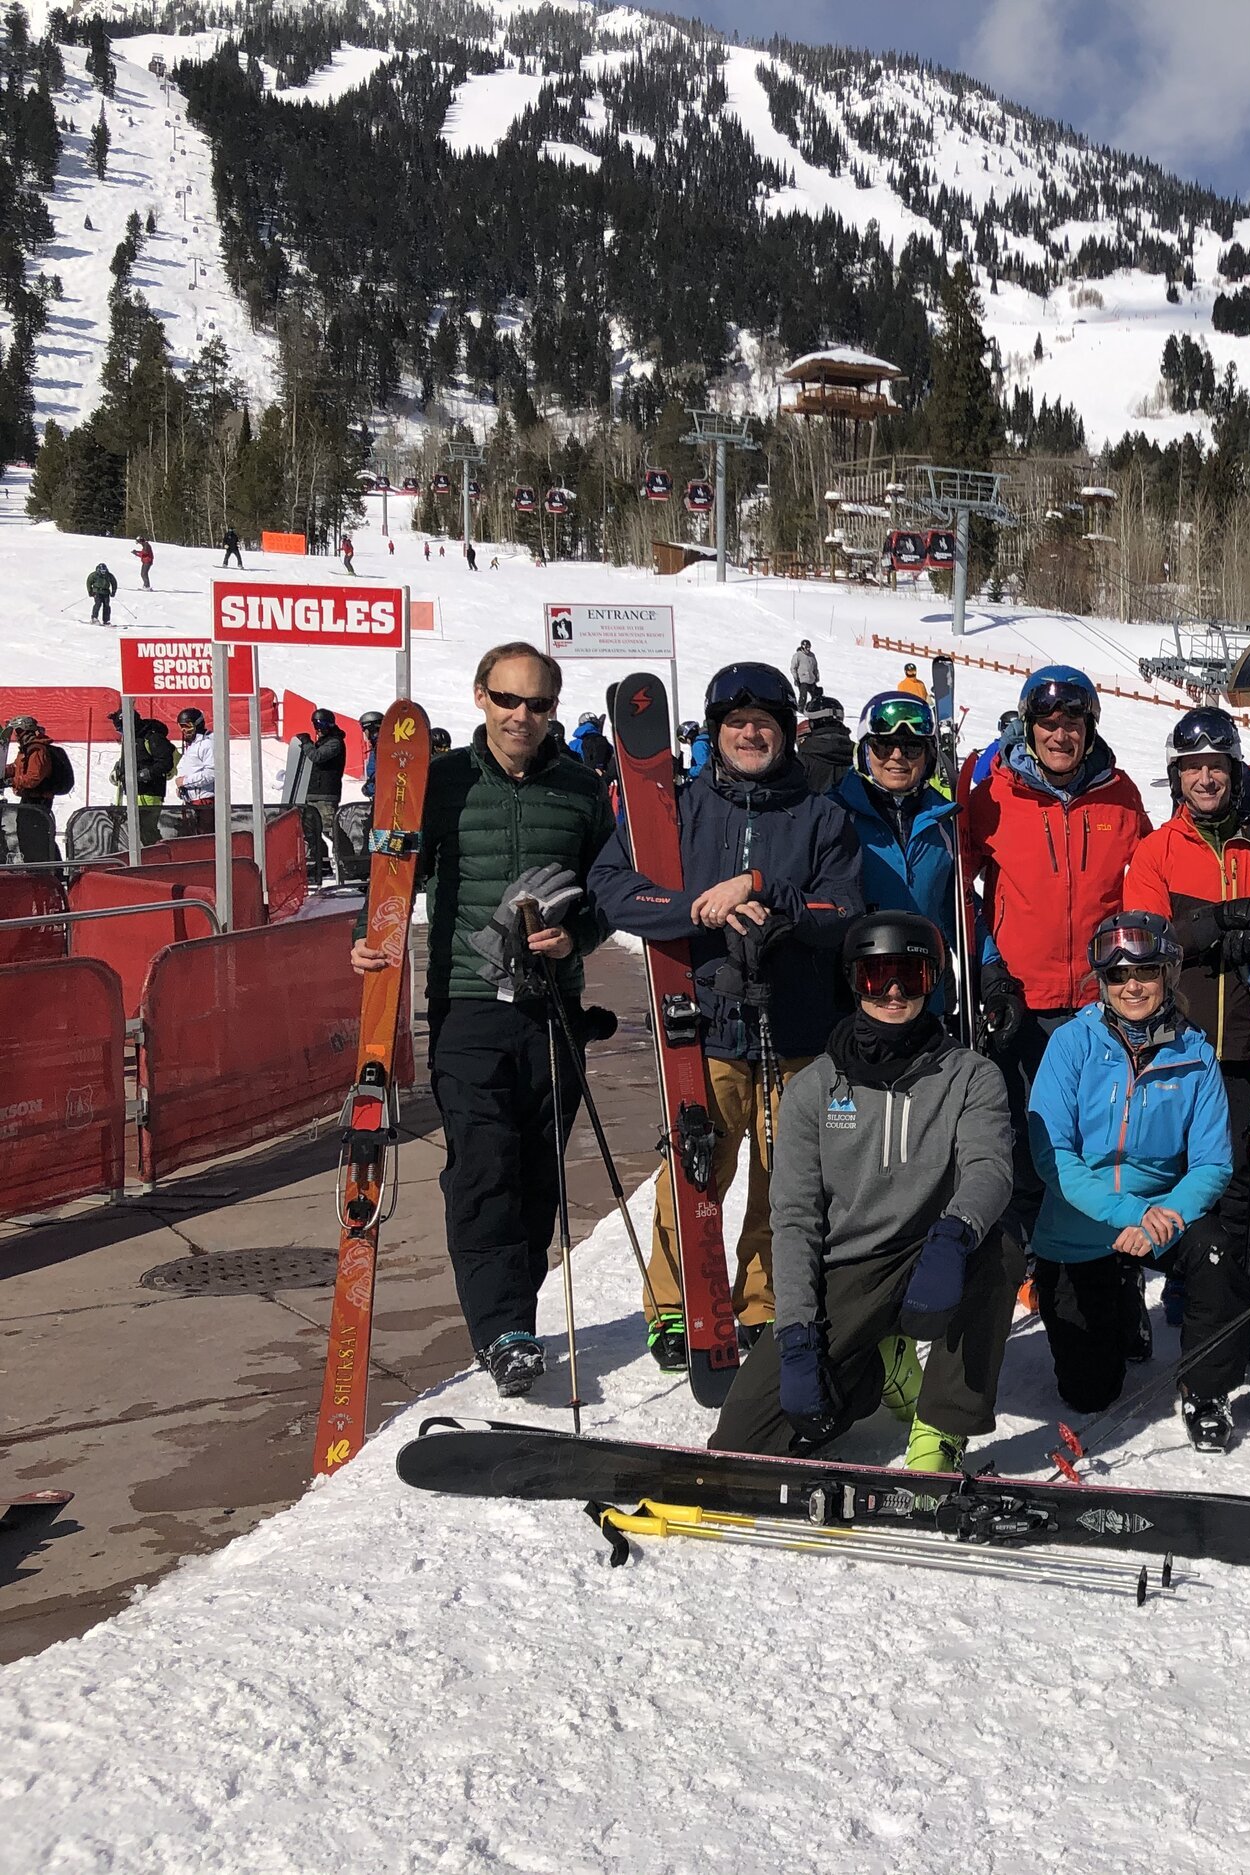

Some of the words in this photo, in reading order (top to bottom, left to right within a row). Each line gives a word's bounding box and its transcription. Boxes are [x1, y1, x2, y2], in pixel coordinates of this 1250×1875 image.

[221, 595, 396, 634] SINGLES
[587, 609, 657, 621] ENTRANCE
[137, 643, 235, 658] MOUNTAN
[388, 773, 407, 875] SHUKN
[635, 895, 671, 904] FLYLOW
[906, 945, 929, 954] GIRO
[827, 1113, 857, 1121] SILICON
[825, 1121, 857, 1129] COULOIR
[694, 1207, 718, 1218] CORE
[334, 1326, 357, 1406] SHUKSAN
